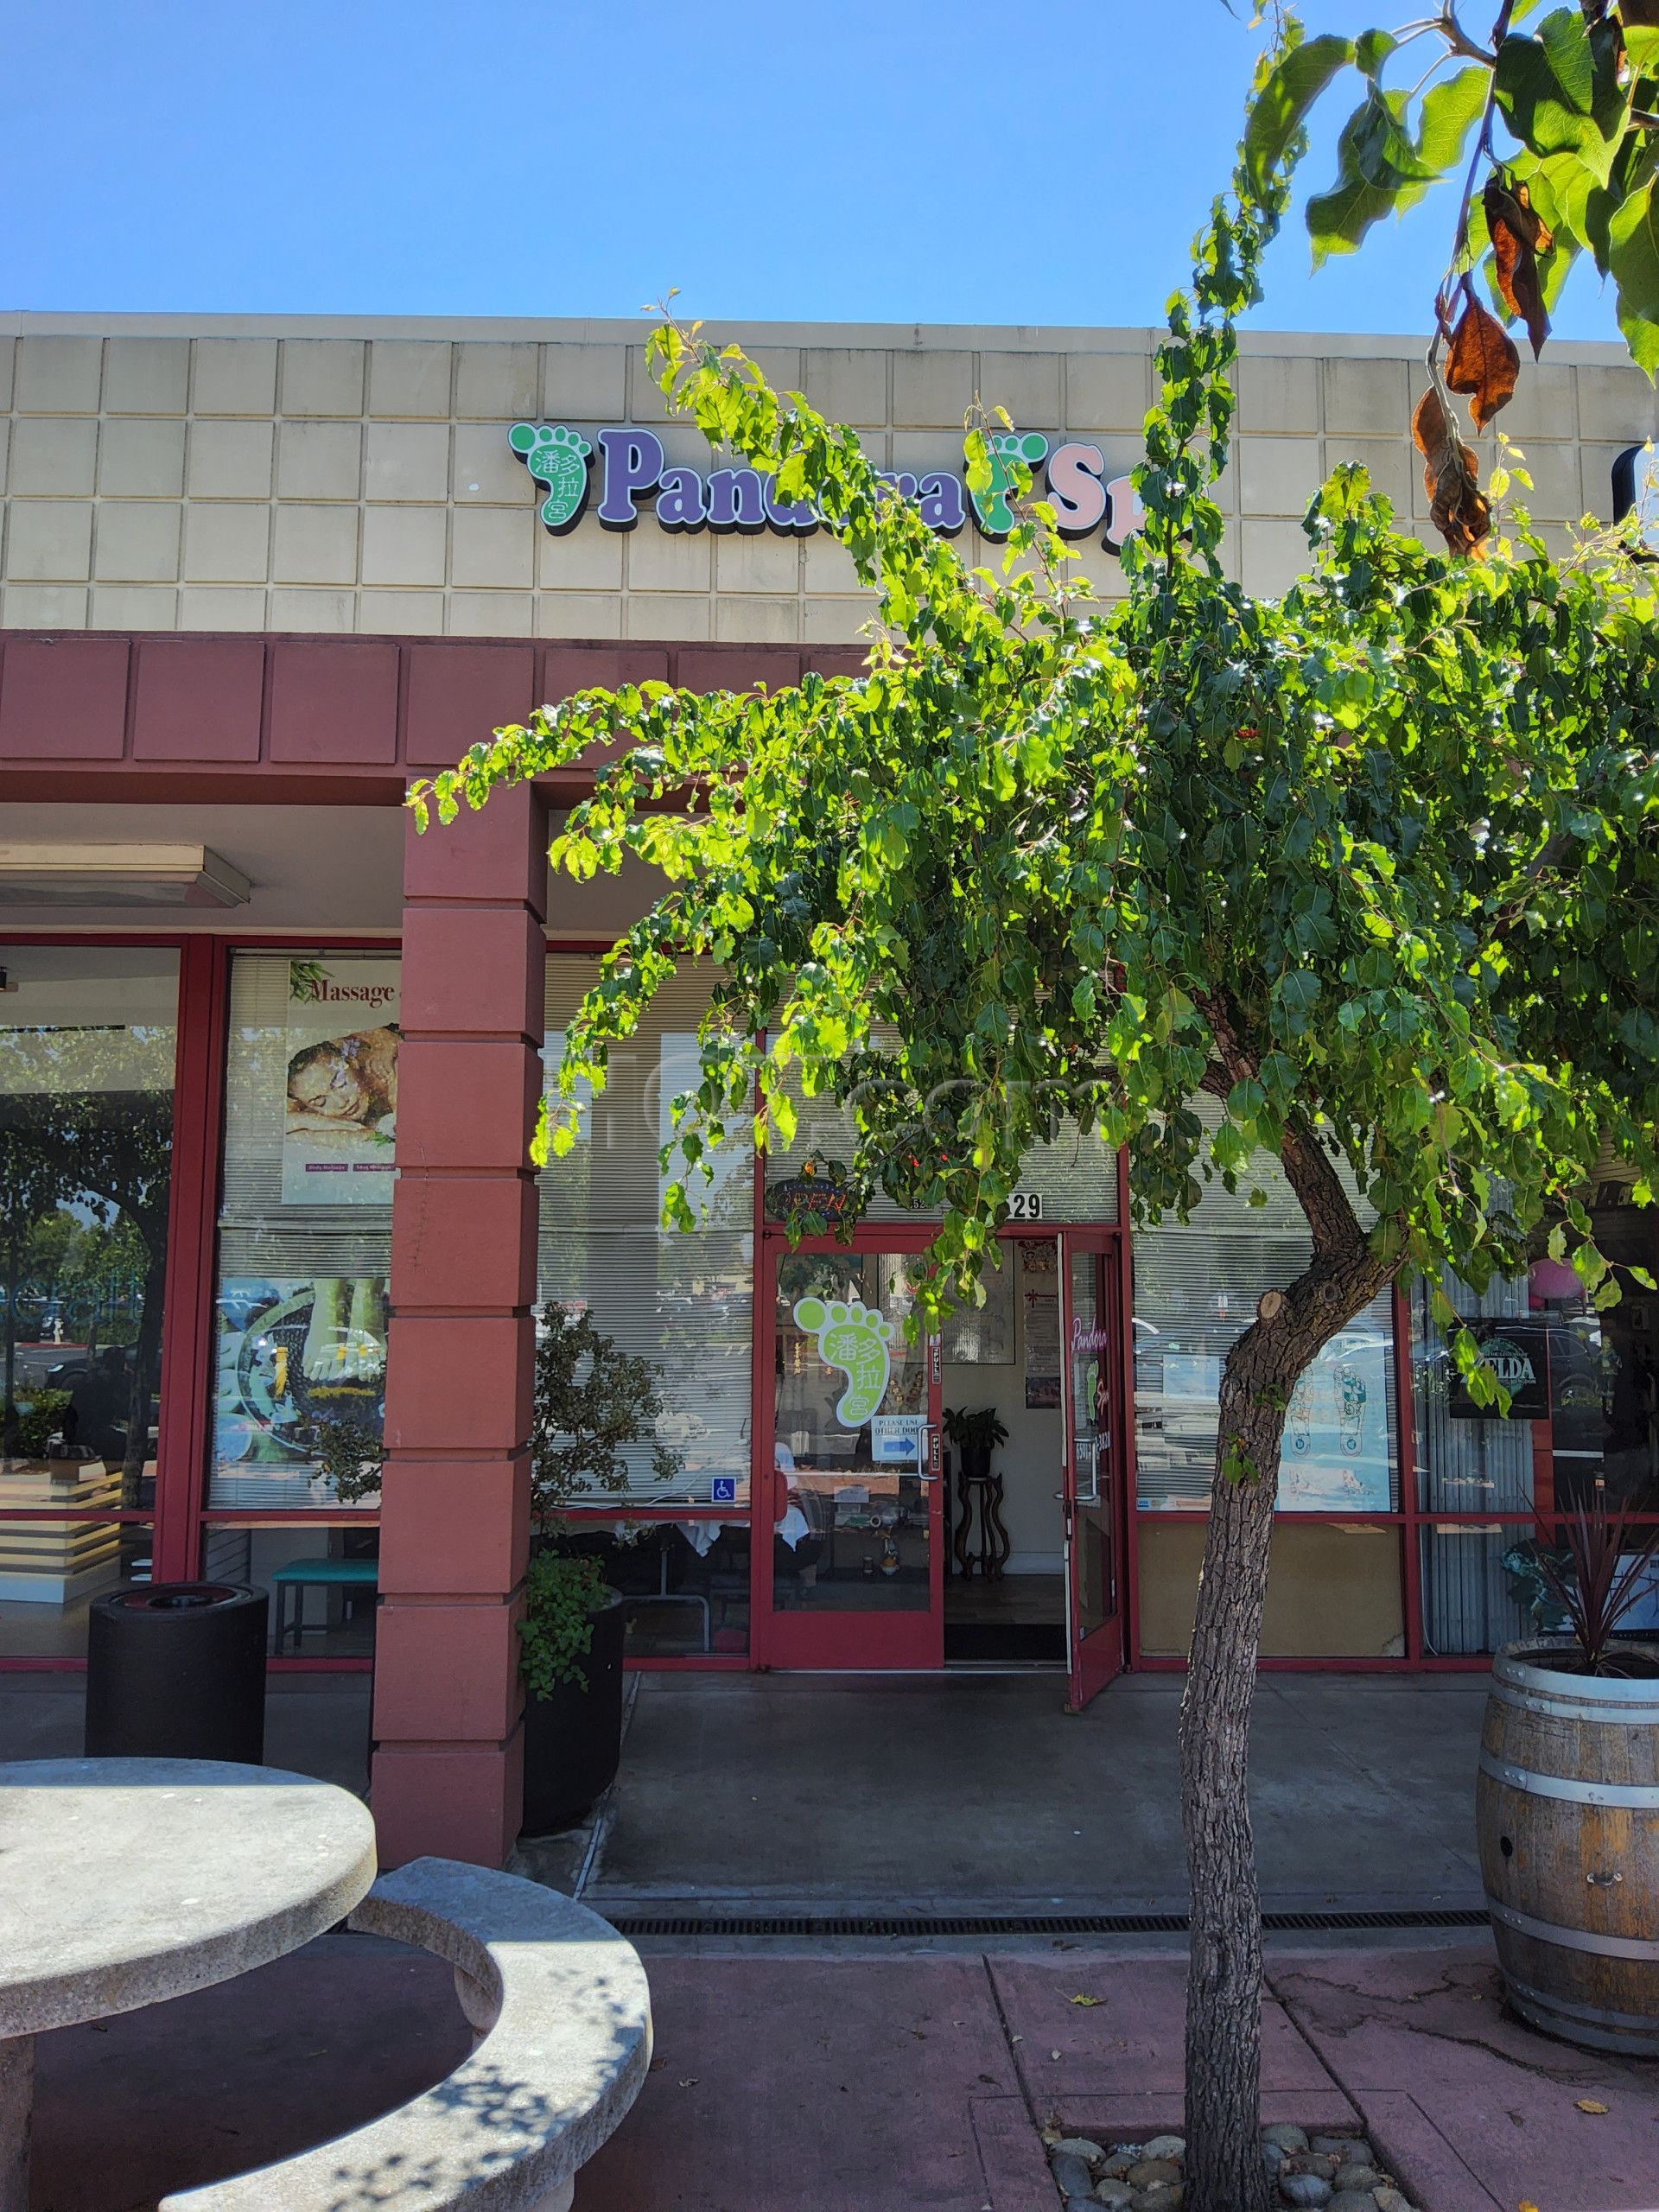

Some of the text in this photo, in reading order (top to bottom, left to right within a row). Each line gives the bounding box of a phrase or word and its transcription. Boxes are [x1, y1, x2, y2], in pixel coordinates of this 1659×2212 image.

[597, 428, 966, 529] Panra
[310, 979, 395, 1009] Massage
[1007, 1193, 1040, 1218] 29
[1072, 1318, 1107, 1350] Pandora
